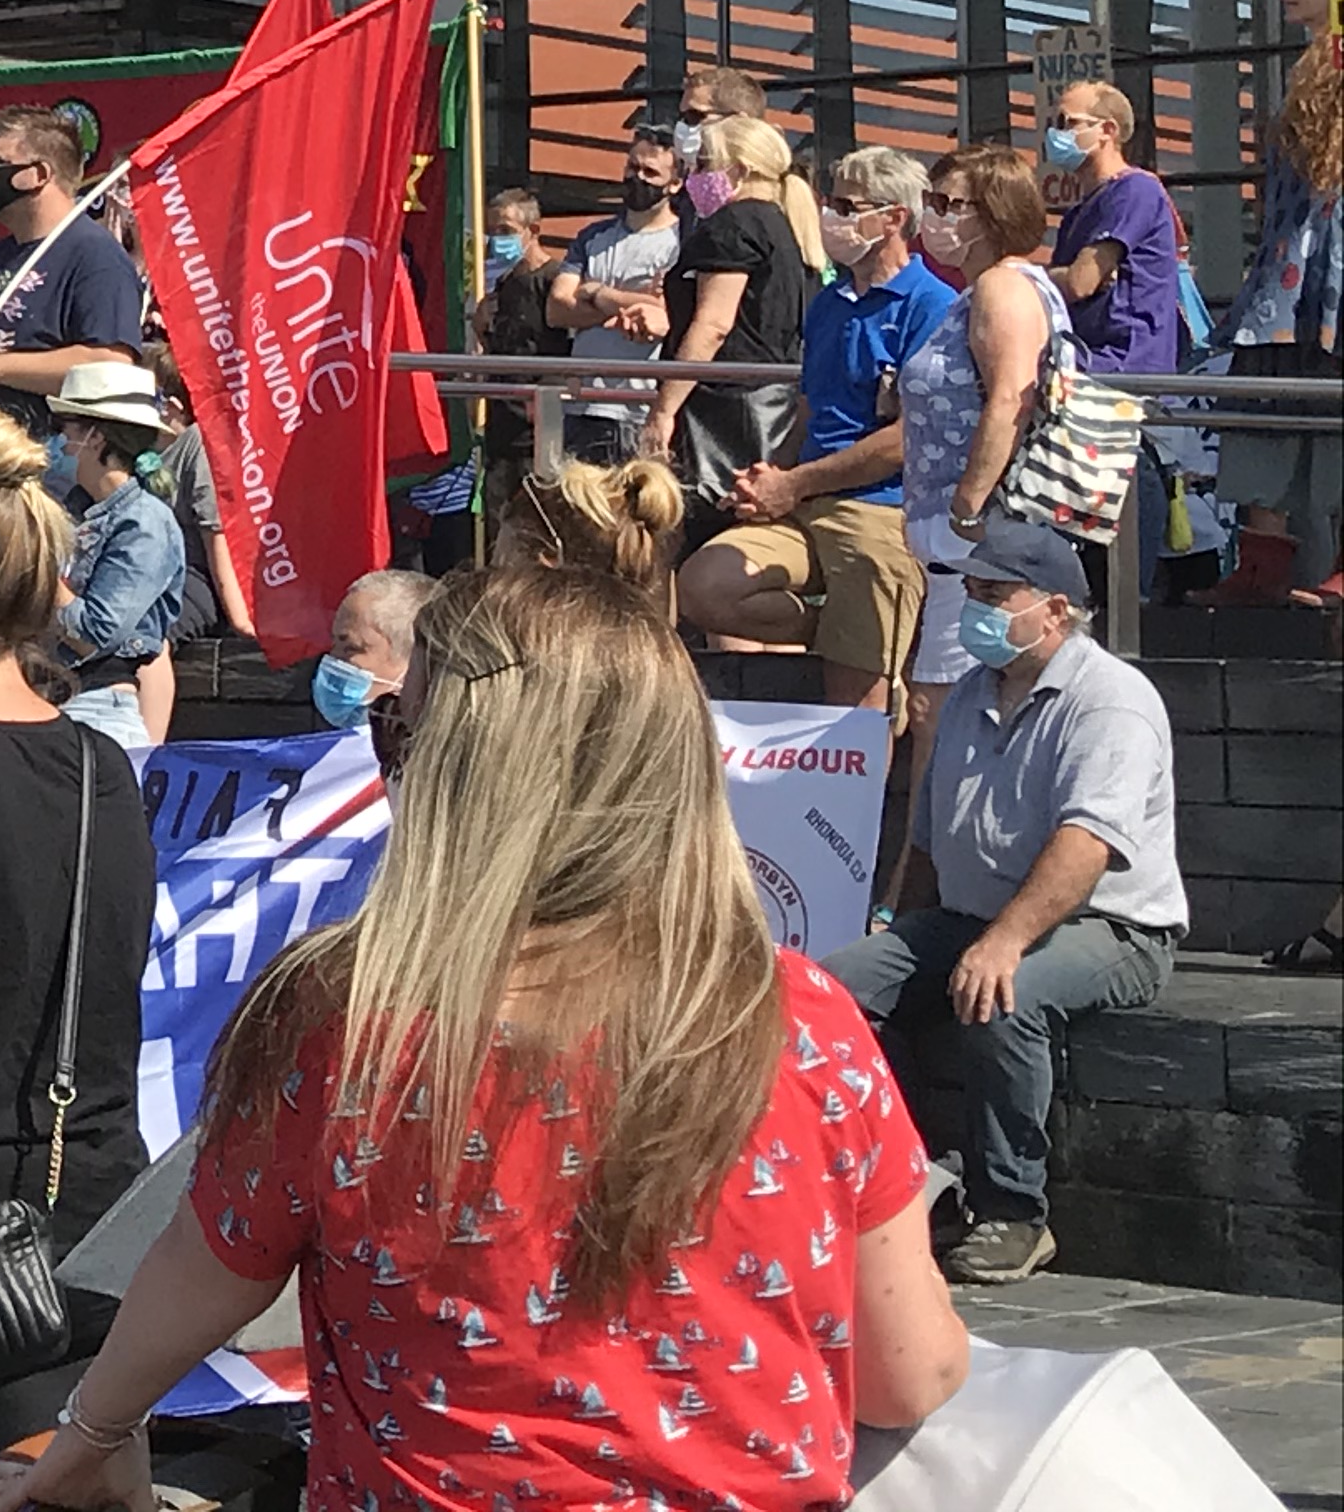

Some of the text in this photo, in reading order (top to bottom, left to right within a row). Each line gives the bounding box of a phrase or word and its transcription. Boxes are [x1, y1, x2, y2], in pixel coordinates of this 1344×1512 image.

[1064, 29, 1077, 51] A
[1038, 55, 1106, 82] NURSE
[742, 746, 868, 777] LABOUR
[748, 854, 797, 908] ORBYN
